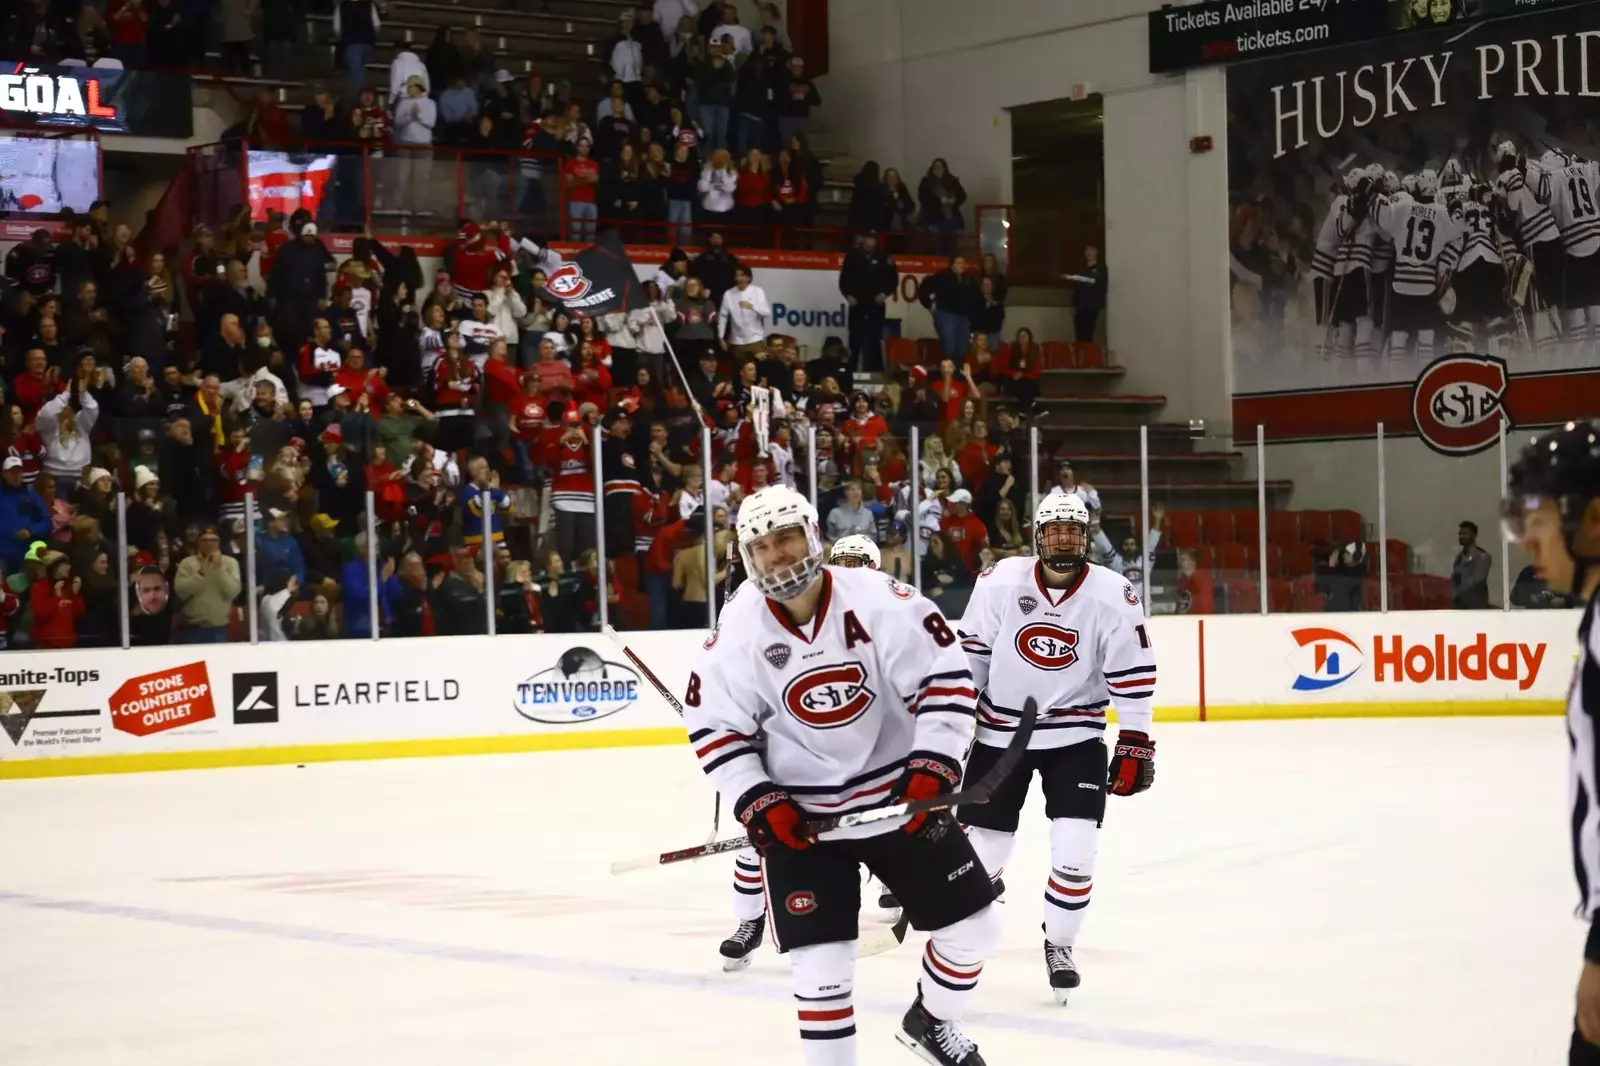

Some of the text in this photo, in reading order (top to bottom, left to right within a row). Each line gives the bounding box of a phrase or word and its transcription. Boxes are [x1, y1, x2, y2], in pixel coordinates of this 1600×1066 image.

[1165, 9, 1220, 33] Tickets
[1224, 0, 1294, 23] Available
[1271, 51, 1453, 159] HUSKY
[1567, 177, 1596, 219] 19
[1402, 216, 1436, 261] 13
[772, 303, 845, 328] Pound
[1019, 599, 1037, 607] NCHC
[843, 609, 872, 649] A
[923, 612, 956, 648] 8
[1134, 623, 1152, 649] 1
[766, 647, 790, 659] NCHC
[1373, 633, 1548, 691] Holiday
[138, 673, 185, 697] STONE
[294, 677, 460, 708] LEARFIELD
[517, 680, 639, 705] TENVOORDE
[120, 683, 209, 717] COUNTERTOP
[142, 703, 193, 727] OUTLET
[24, 739, 34, 747] the
[36, 737, 60, 746] World's
[83, 735, 102, 743] Stone
[33, 729, 58, 737] Premier
[60, 727, 92, 736] Fabricator
[1077, 782, 1100, 791] CCM
[740, 791, 788, 825] CCM
[699, 837, 752, 855] JETSPE
[948, 860, 975, 881] CCM
